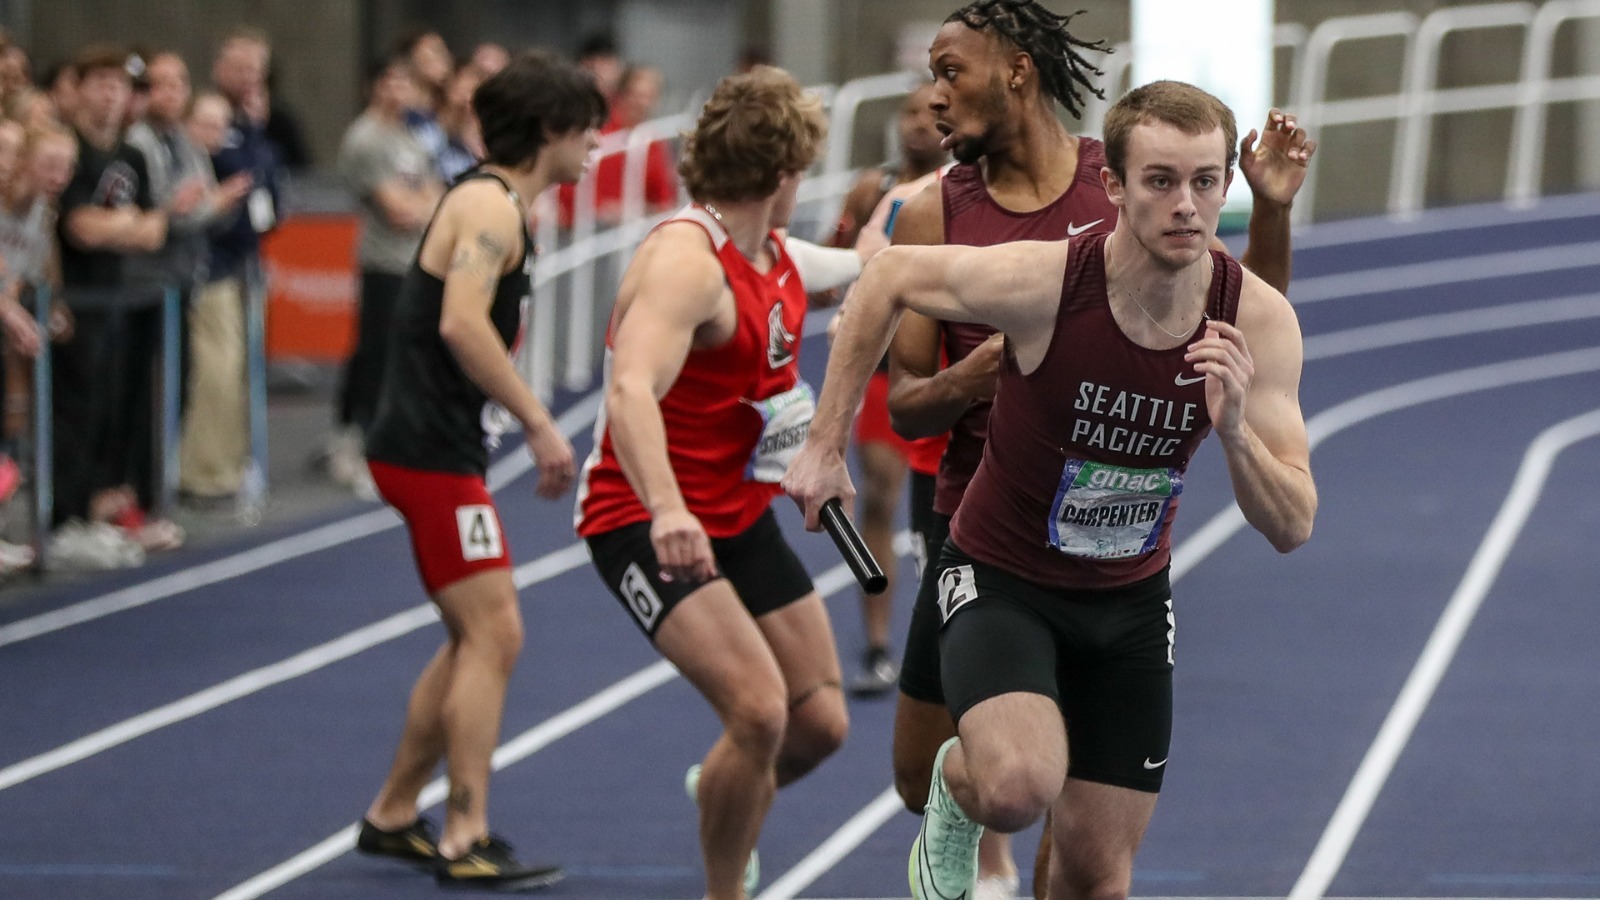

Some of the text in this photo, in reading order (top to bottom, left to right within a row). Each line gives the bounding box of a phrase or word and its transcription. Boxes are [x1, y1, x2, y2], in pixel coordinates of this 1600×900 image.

[1073, 381, 1197, 431] SEATTLE
[1071, 418, 1181, 456] PACIFIC
[1087, 468, 1161, 492] gnac
[469, 512, 491, 549] 4
[1060, 501, 1160, 527] CARPENTER
[626, 574, 653, 617] 6
[942, 567, 968, 616] 2
